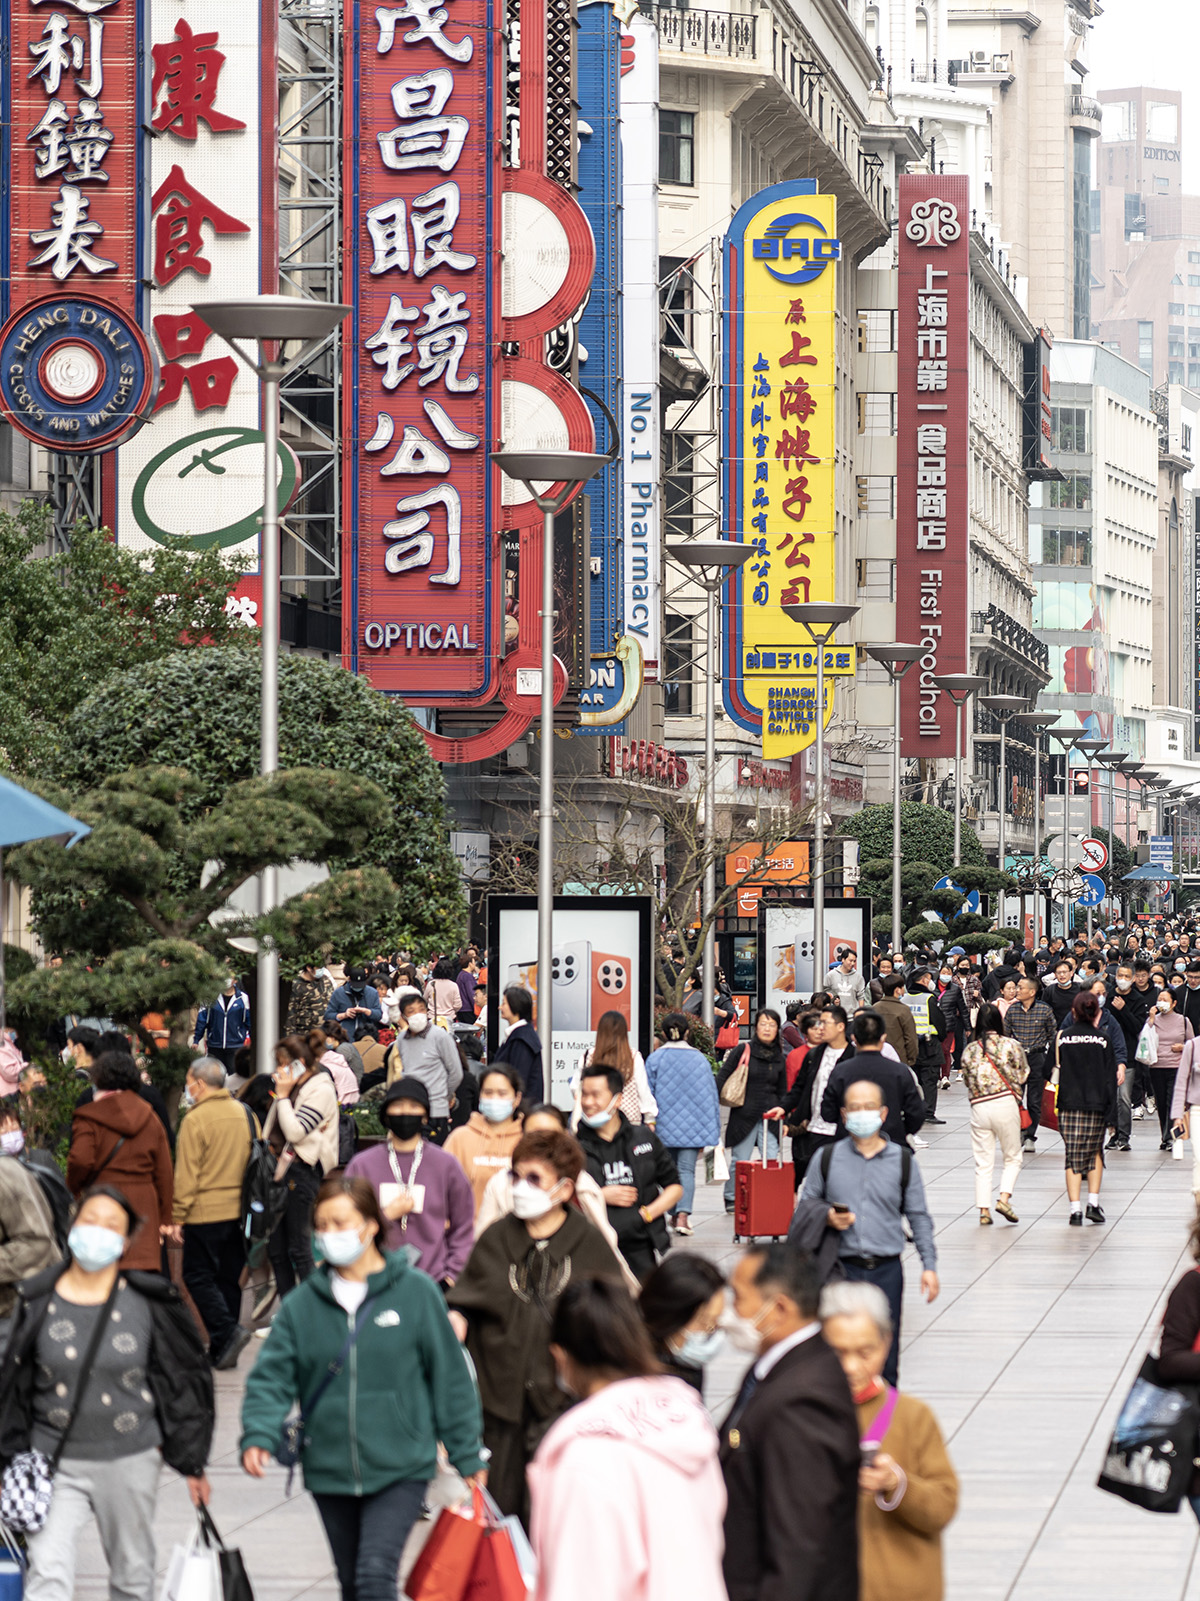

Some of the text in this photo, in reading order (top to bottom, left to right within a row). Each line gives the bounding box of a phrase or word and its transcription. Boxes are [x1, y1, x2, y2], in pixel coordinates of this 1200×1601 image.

[28, 0, 118, 280] 利鐘表
[1143, 146, 1181, 162] EDITION
[14, 307, 133, 352] HENG DALI
[10, 363, 135, 431] CLOCKS AND WATCHES
[917, 264, 948, 551] 上海市第一食品商店
[627, 482, 653, 638] Pharmacy
[364, 622, 479, 649] OPTICAL
[919, 569, 943, 737] First Foodhall
[768, 687, 828, 697] SHANGHI
